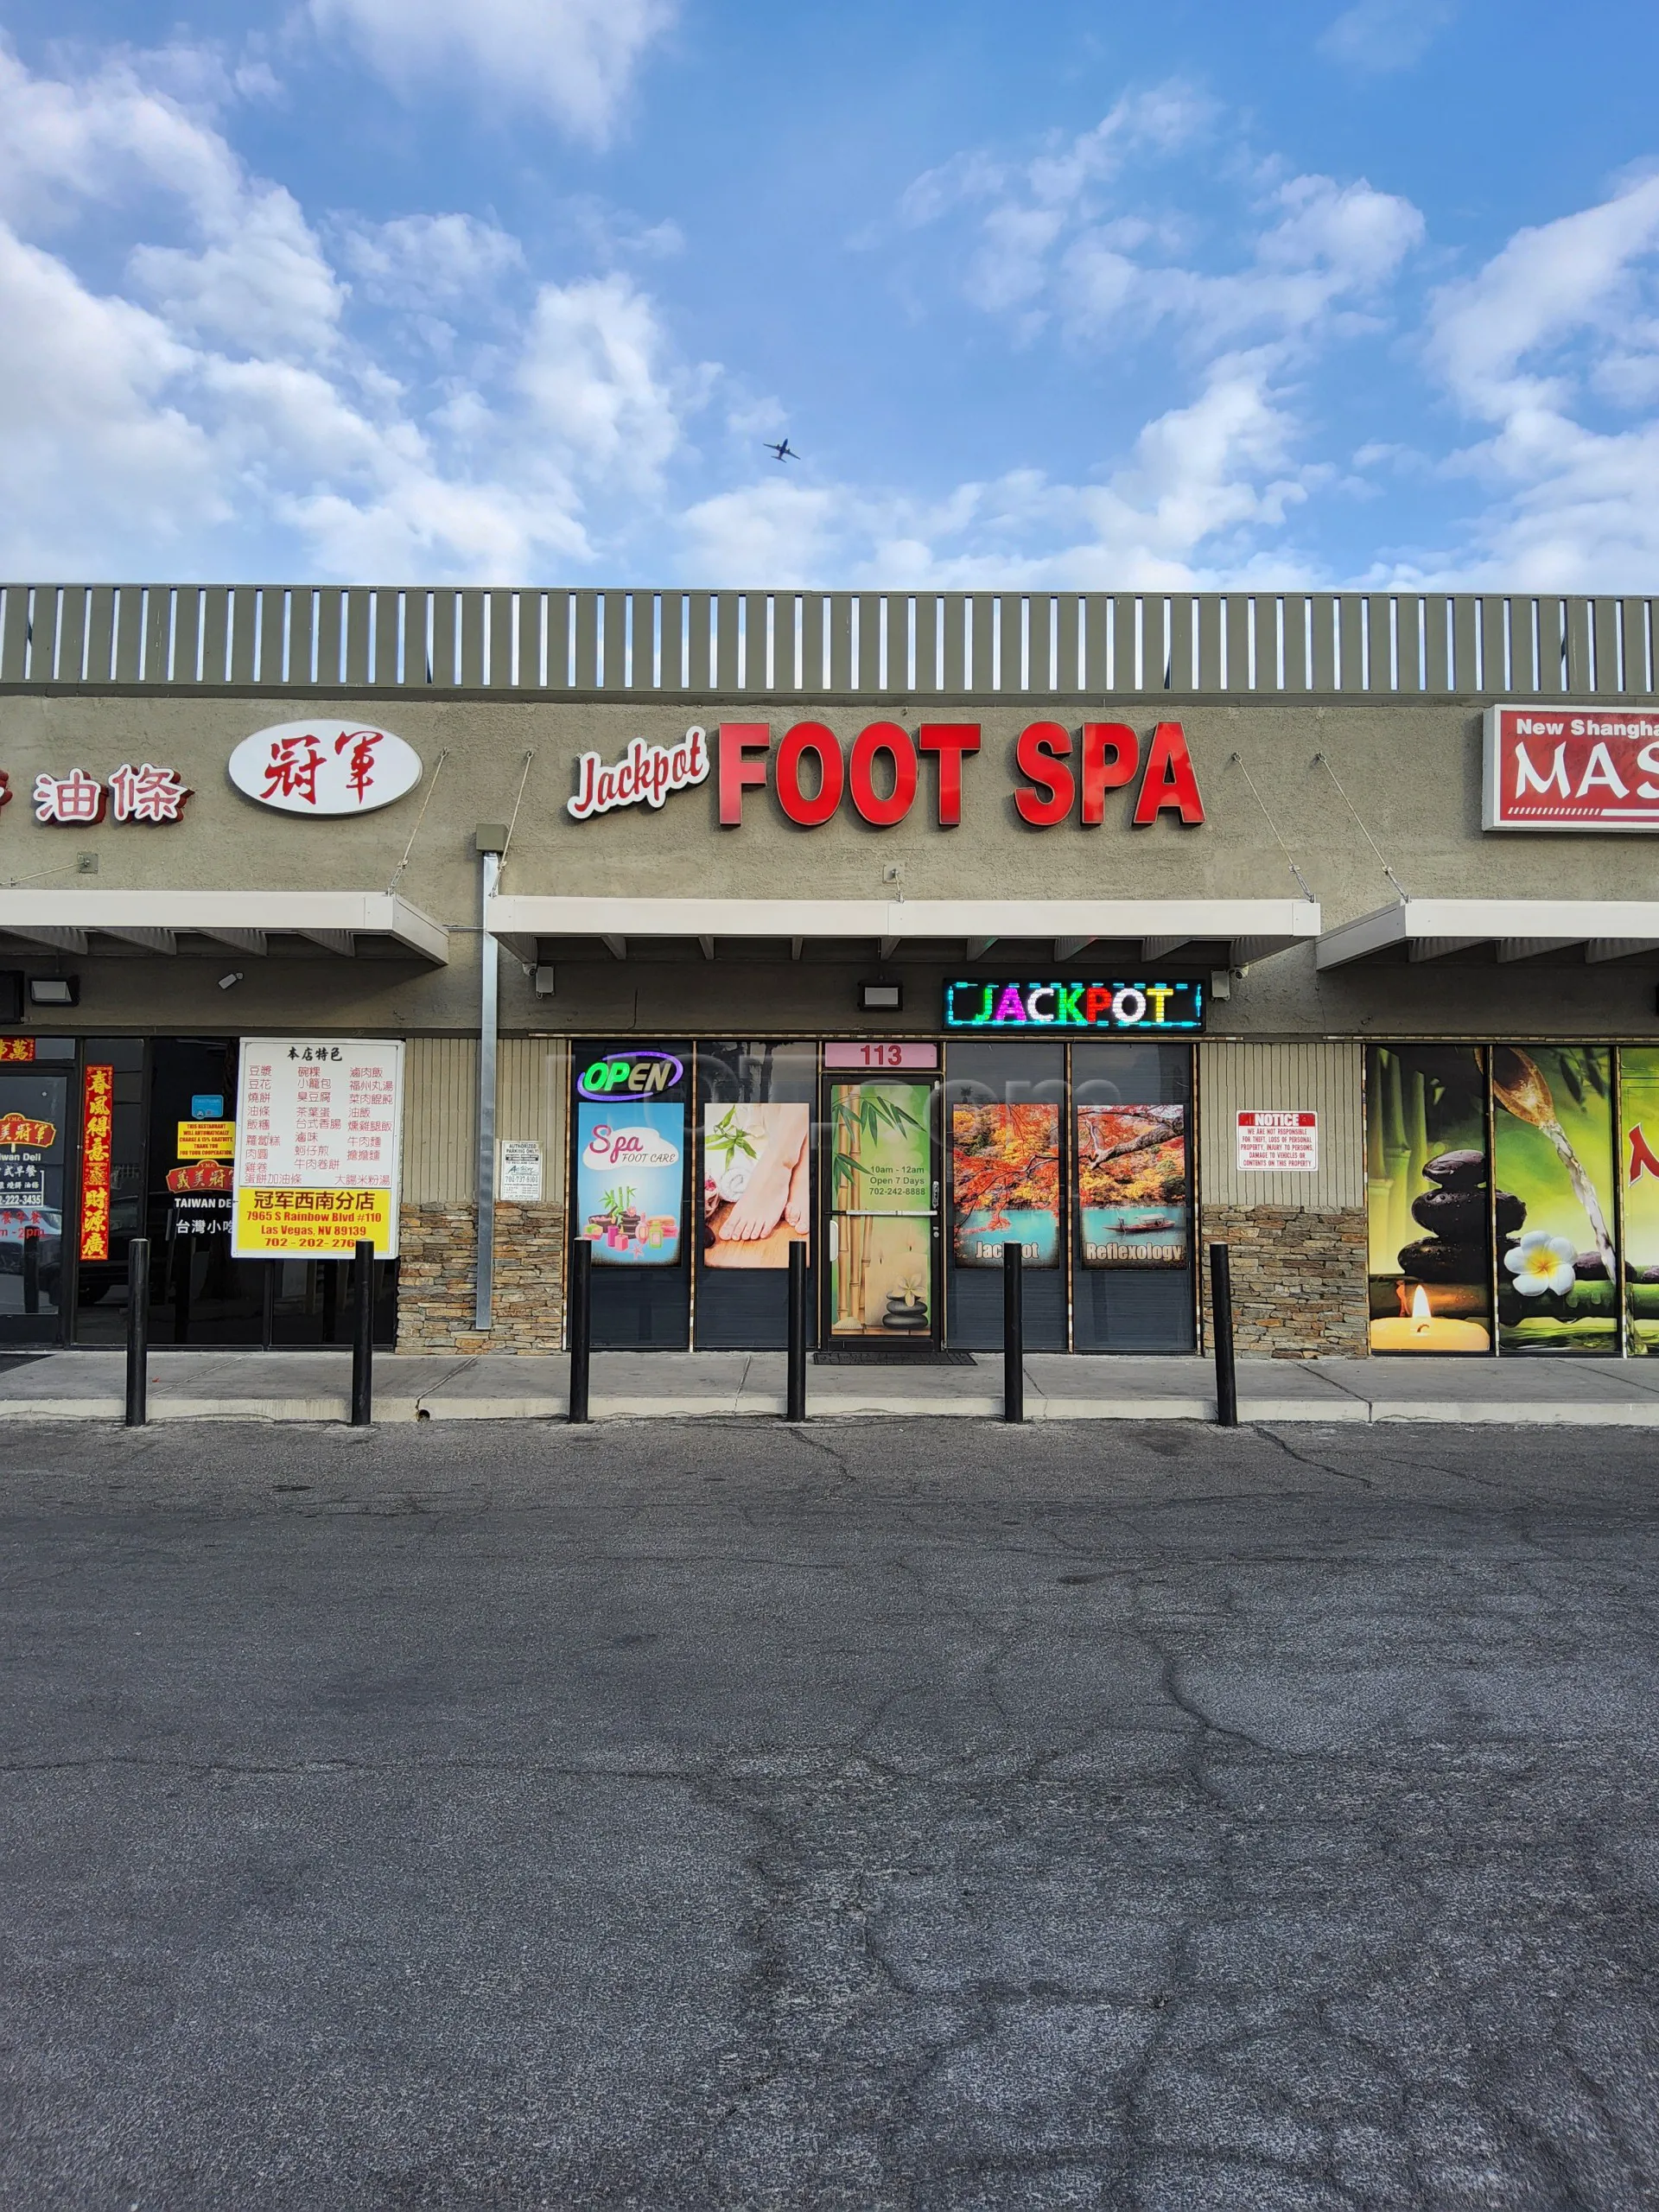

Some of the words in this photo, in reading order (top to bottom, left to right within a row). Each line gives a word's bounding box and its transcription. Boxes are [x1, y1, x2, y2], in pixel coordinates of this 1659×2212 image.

[1516, 719, 1564, 734] New
[259, 731, 385, 804] 冠軍
[569, 728, 707, 816] Jackpot
[719, 721, 981, 826] FOOT
[1015, 721, 1206, 826] SPA
[33, 763, 188, 821] 油條
[975, 988, 1174, 1023] JACKPOT
[287, 1046, 342, 1061] 本店特色
[861, 1045, 902, 1065] 113
[297, 1066, 321, 1077] 碗粿
[350, 1067, 383, 1078] 滷肉飯
[583, 1062, 671, 1091] OPEN
[249, 1078, 271, 1090] 豆花
[297, 1077, 331, 1089] 小籠包
[350, 1080, 393, 1091] 福州丸湯
[248, 1092, 270, 1103] 燒餅
[296, 1091, 331, 1103] 臭豆腐
[349, 1094, 393, 1105] 菜肉餛飩
[247, 1106, 270, 1116] 油條
[296, 1107, 330, 1117] 茶葉蛋
[348, 1108, 370, 1118] 油飯
[296, 1118, 341, 1129] 台式香腸
[1255, 1114, 1299, 1126] NOTICE
[295, 1131, 318, 1142] 滷味
[347, 1135, 381, 1147] 牛肉麵
[588, 1125, 643, 1163] Spa
[245, 1148, 268, 1160] 肉圓
[295, 1145, 328, 1156] 蚵仔煎
[22, 1153, 41, 1161] Deli
[622, 1153, 648, 1162] FOOT
[650, 1153, 676, 1162] CARE
[0, 1165, 37, 1178] 式早餐
[245, 1173, 302, 1184] 蛋餅加油條
[334, 1174, 390, 1185] 大腸米粉湯
[870, 1177, 893, 1185] Open
[903, 1177, 925, 1185] Days
[175, 1198, 215, 1208] TAIWAN
[254, 1191, 375, 1210] 冠军西南分店
[246, 1211, 272, 1220] 7965
[284, 1212, 329, 1222] Rainbow
[332, 1212, 354, 1222] Blvd
[357, 1213, 381, 1222] #110
[176, 1219, 232, 1234] 台灣小吃
[261, 1225, 278, 1235] Las
[281, 1225, 315, 1236] Vegas,
[318, 1226, 331, 1235] NV
[334, 1226, 366, 1236] 89139
[265, 1238, 288, 1247] 702
[976, 1241, 1039, 1259] Jacot
[1086, 1242, 1183, 1261] Reflexology
